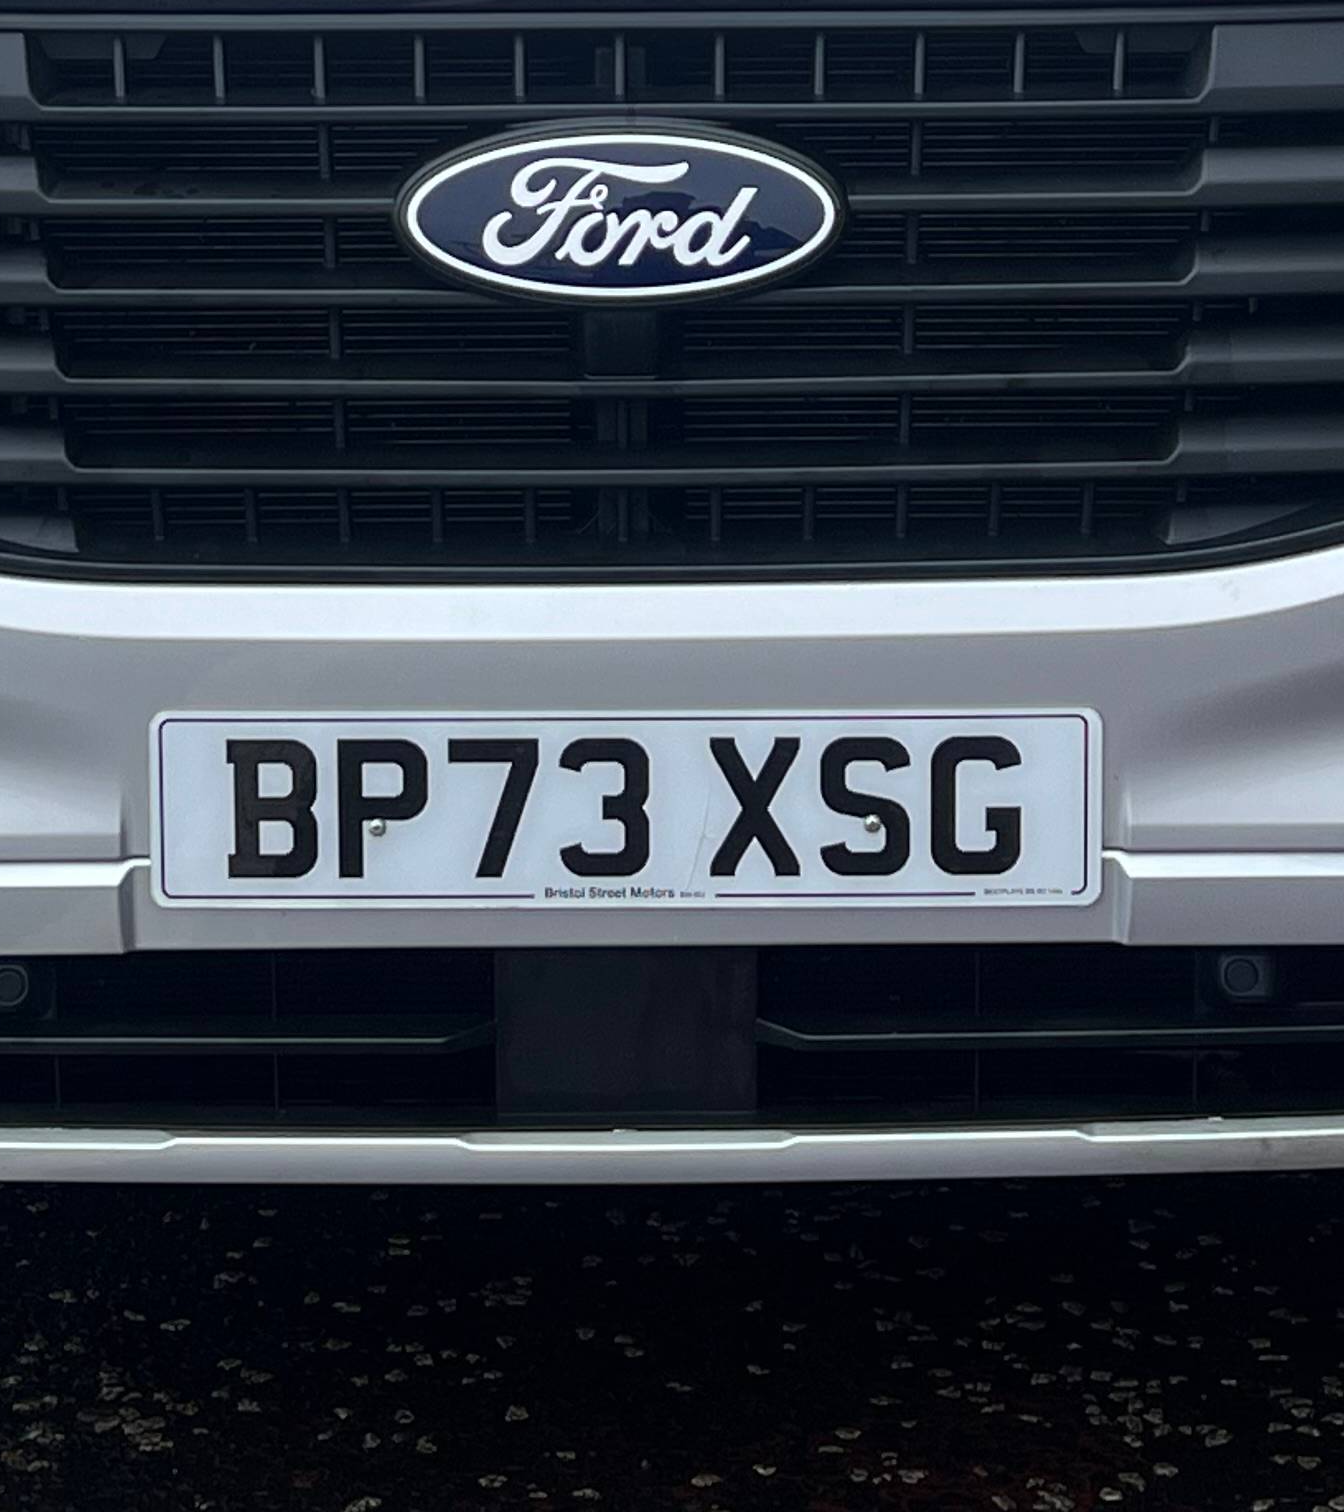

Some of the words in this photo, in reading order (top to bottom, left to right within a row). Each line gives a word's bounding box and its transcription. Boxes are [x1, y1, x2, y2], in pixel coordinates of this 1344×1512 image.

[482, 157, 758, 267] Ford
[226, 738, 650, 879] BP73
[709, 735, 1022, 877] XSG
[544, 886, 586, 899] Bristol
[588, 886, 627, 899] Street
[630, 886, 676, 899] Motors
